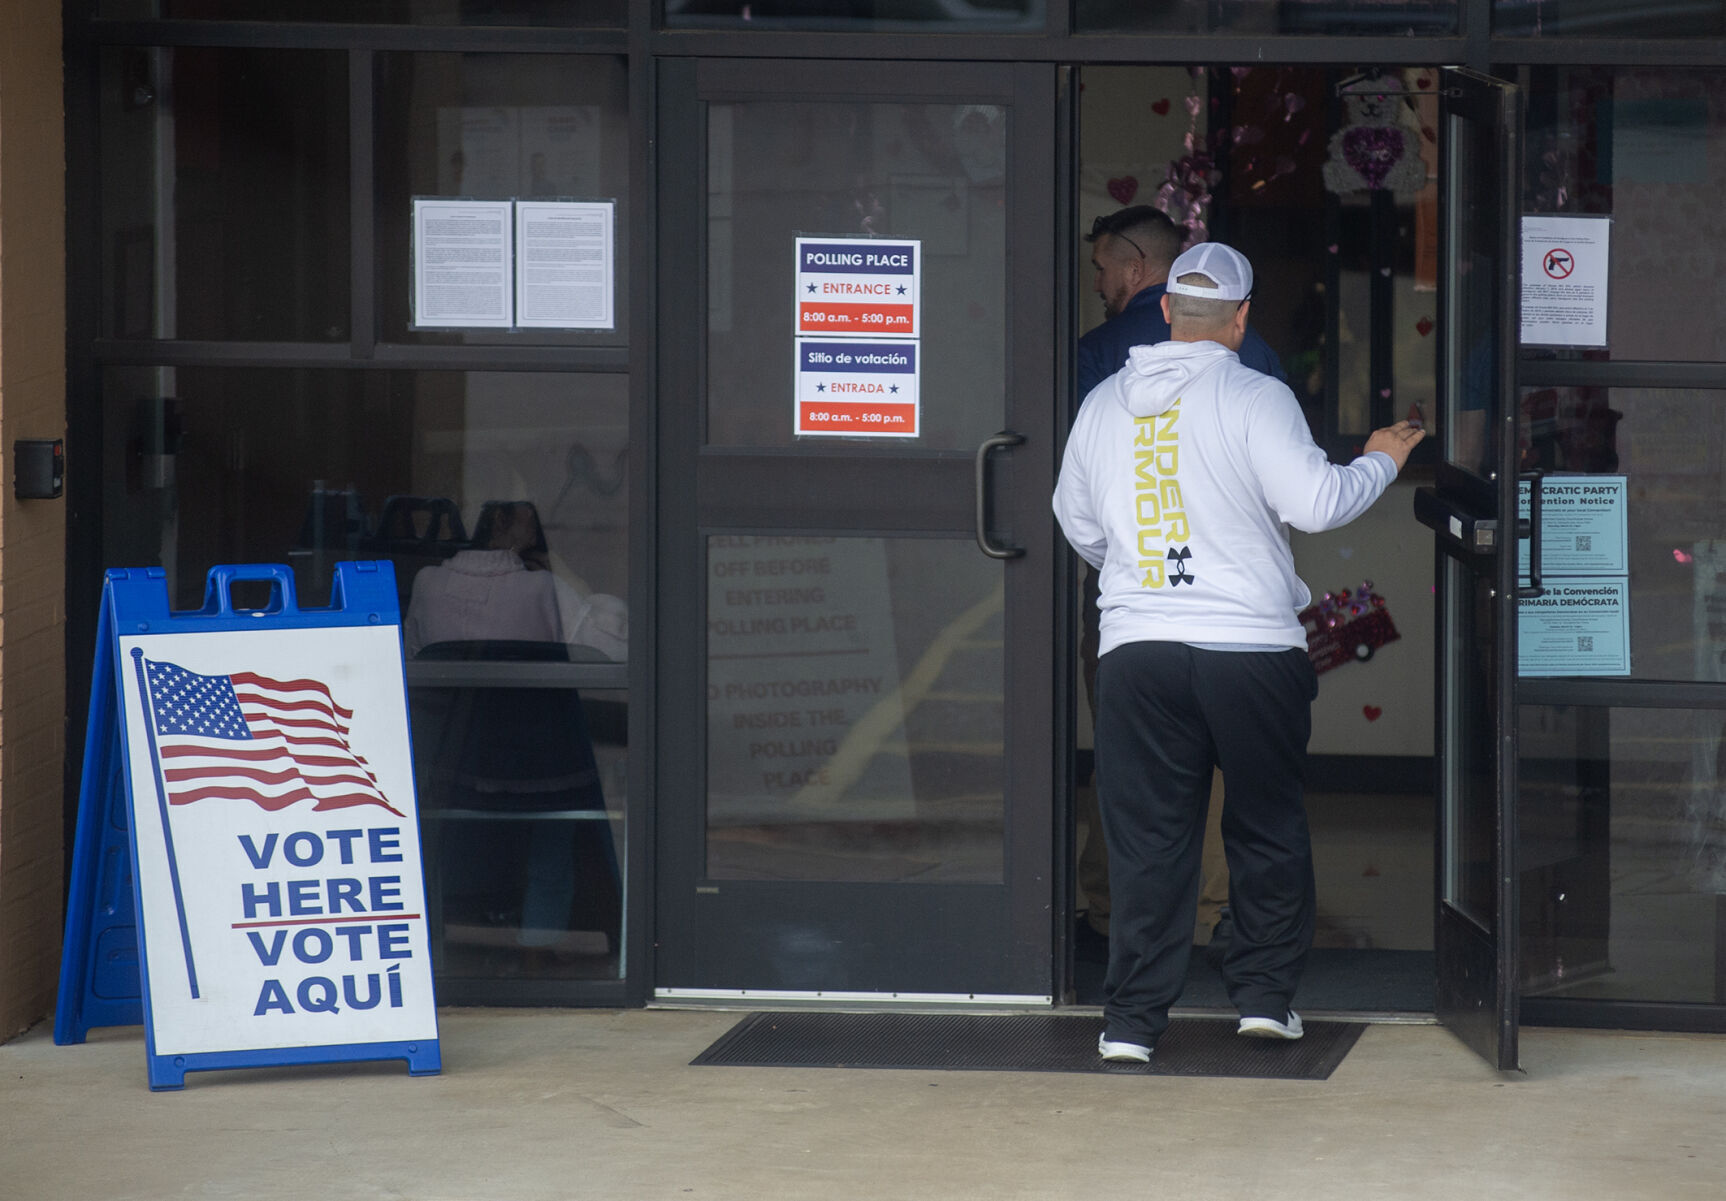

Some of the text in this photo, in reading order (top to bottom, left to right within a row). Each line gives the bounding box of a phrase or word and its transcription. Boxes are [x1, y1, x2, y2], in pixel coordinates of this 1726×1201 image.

[806, 253, 908, 267] POLLING PLACE
[823, 282, 891, 295] ENTRANCE
[803, 312, 825, 322] 8:00
[827, 313, 852, 323] a.m.
[861, 313, 884, 324] 5:00
[886, 315, 910, 326] p.m.
[808, 352, 908, 365] Sitio de votación
[831, 382, 885, 393] ENTRADA
[809, 412, 829, 422] 8:00
[831, 414, 853, 422] a.m.
[861, 413, 882, 423] 5:00
[883, 414, 905, 425] p.m.
[1155, 397, 1191, 543] NDER
[1519, 486, 1619, 495] EMCRATIC PARTY
[1134, 415, 1166, 589] RMOUR
[1521, 497, 1615, 505] oention Notice
[754, 558, 831, 575] BEFORE
[726, 588, 824, 605] ENTERING
[1553, 588, 1562, 596] la
[1563, 586, 1619, 596] Convención
[1560, 597, 1619, 606] DEMÓCRATA
[791, 614, 857, 633] PLACE
[725, 678, 882, 698] PHOTOGRAPHY
[734, 709, 848, 729] INSIDE THE
[751, 739, 837, 758] POLLING
[237, 827, 403, 870] VOTE
[241, 875, 404, 919] HERE
[246, 923, 413, 967] VOTE
[253, 962, 403, 1017] AQUÍ
